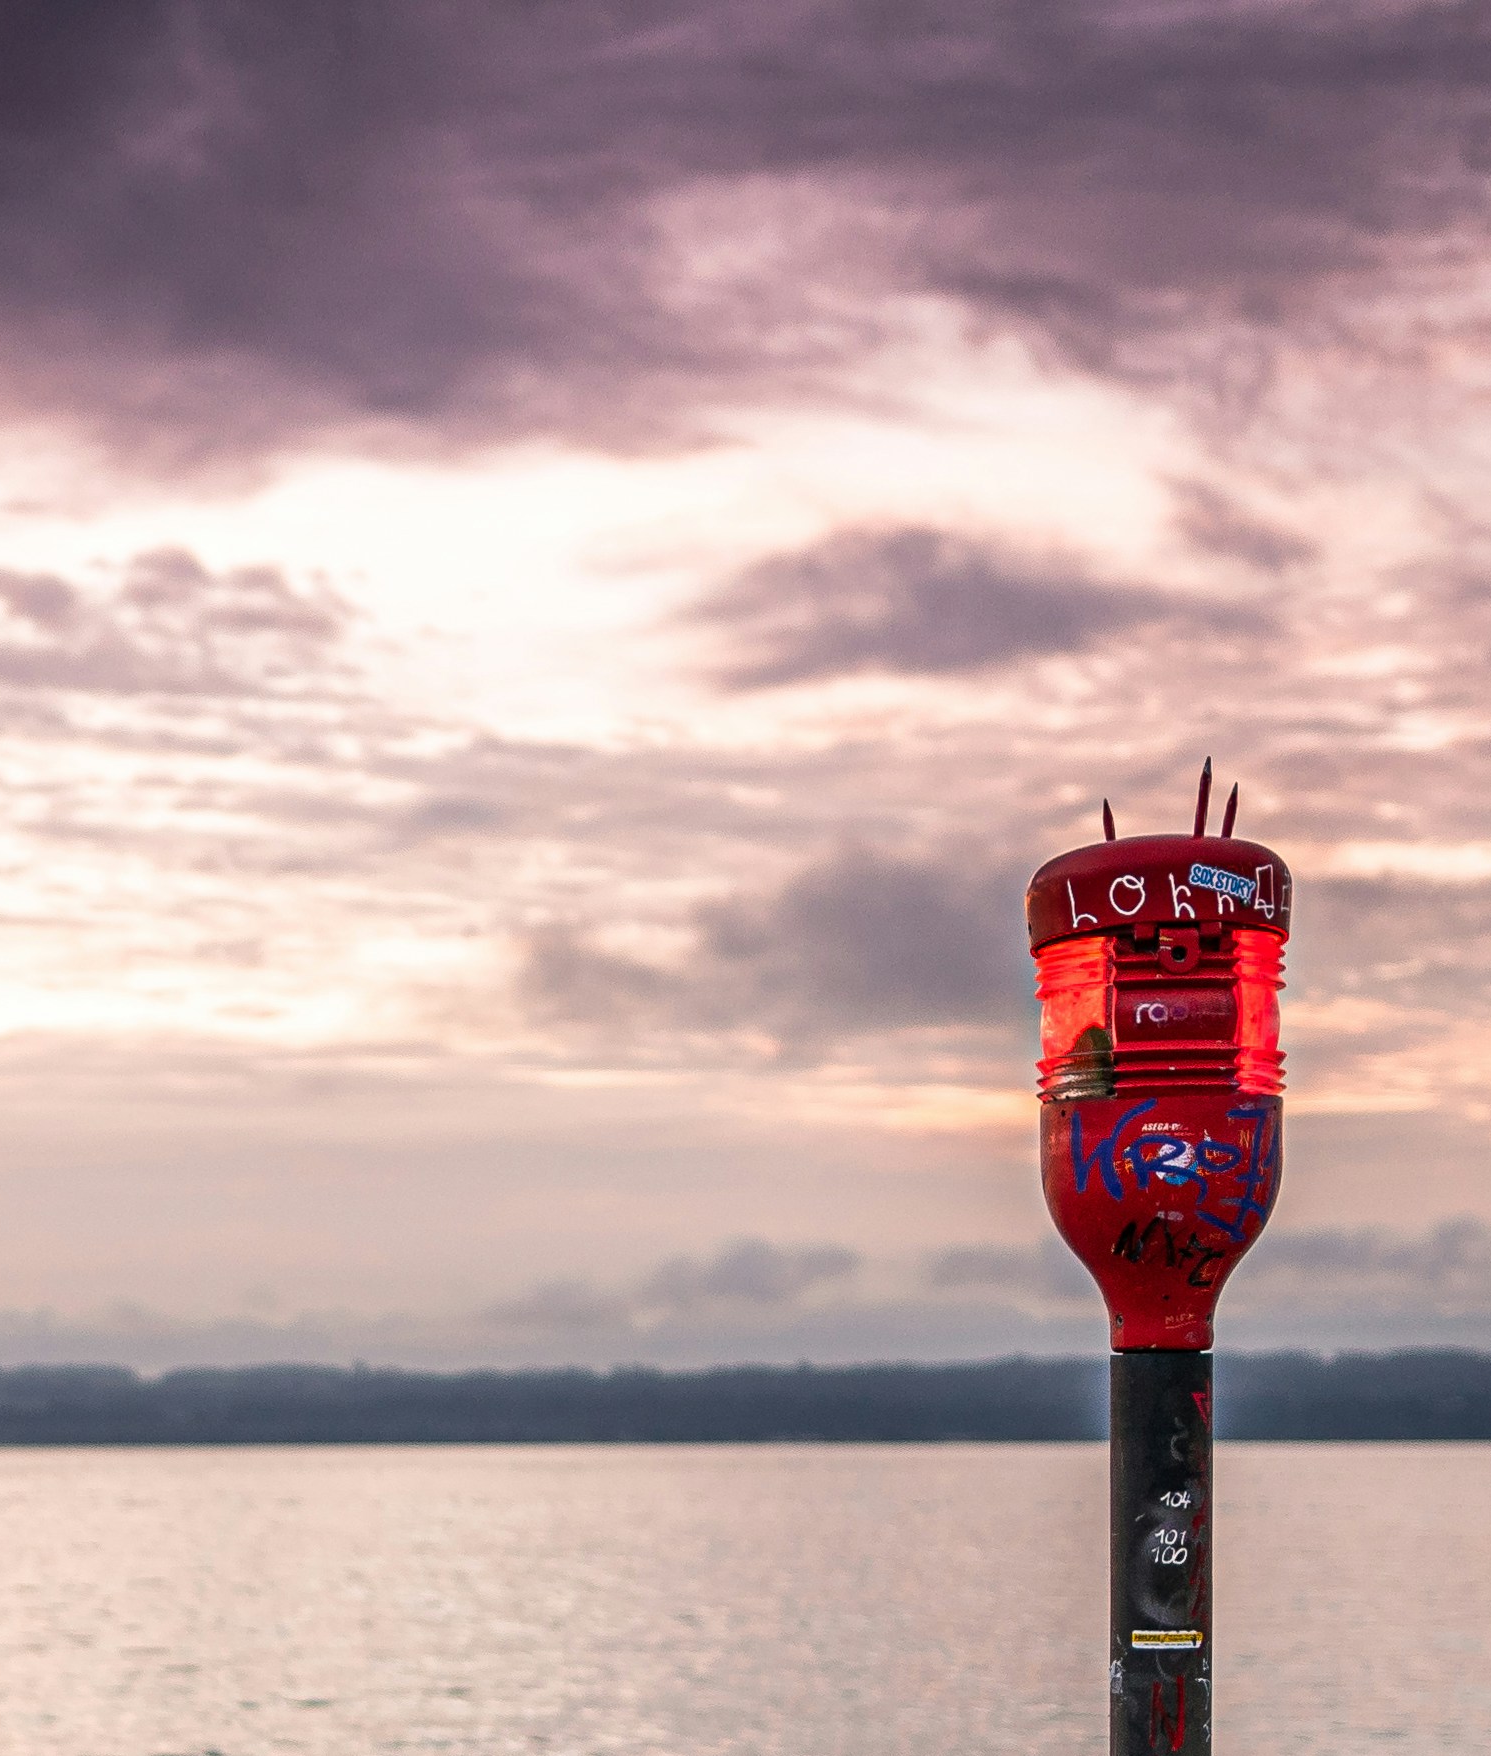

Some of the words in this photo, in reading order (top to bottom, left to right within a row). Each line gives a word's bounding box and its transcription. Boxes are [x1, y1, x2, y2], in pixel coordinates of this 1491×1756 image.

[1190, 864, 1216, 888] SOX
[1215, 870, 1255, 899] STORY
[1160, 1491, 1191, 1509] 104
[1154, 1528, 1187, 1546] 101
[1151, 1545, 1188, 1565] 100
